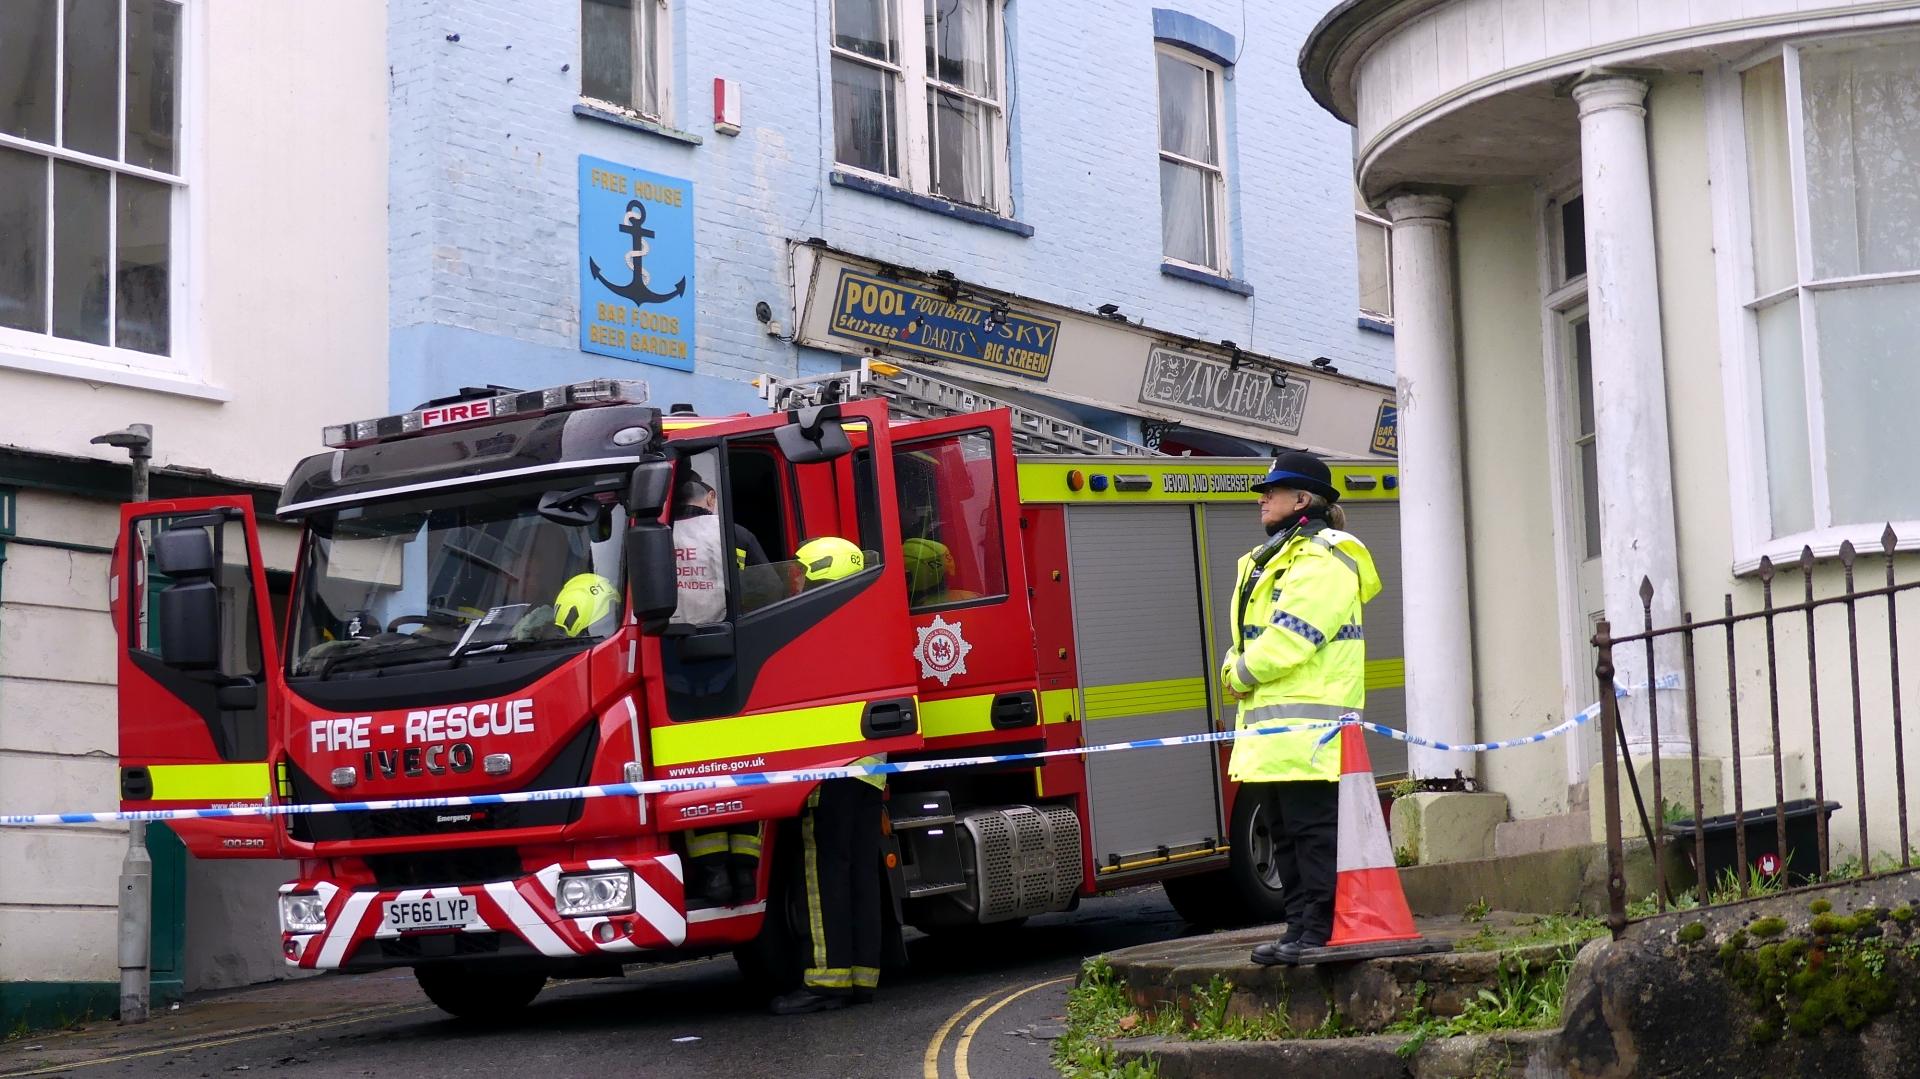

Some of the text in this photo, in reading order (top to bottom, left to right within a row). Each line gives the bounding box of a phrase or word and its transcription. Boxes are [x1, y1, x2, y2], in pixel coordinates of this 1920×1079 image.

[591, 168, 683, 208] FREE HOUSE
[845, 281, 906, 316] POOL
[911, 296, 982, 326] FOOTBALL
[597, 301, 680, 335] BAR FOODS
[839, 314, 899, 339] SKITTLES
[590, 323, 688, 360] BEER GARDEN
[921, 323, 967, 353] DARTS
[997, 322, 1054, 348] SKY
[983, 341, 1048, 373] BIG SCREEN
[1173, 351, 1274, 416] ANCHOR
[423, 402, 489, 425] FIRE
[1378, 425, 1394, 437] BAR
[1162, 473, 1190, 493] DEVON
[1191, 473, 1209, 493] AND
[1209, 473, 1249, 493] SOMERSET
[850, 554, 861, 566] 62
[589, 583, 605, 596] 61
[310, 698, 535, 753] FIRE - RESCUE
[363, 743, 475, 781] IVECO
[668, 756, 766, 777] www.dsfire.gov.uk
[680, 800, 745, 818] 100-210
[390, 899, 469, 924] SF66 LYP
